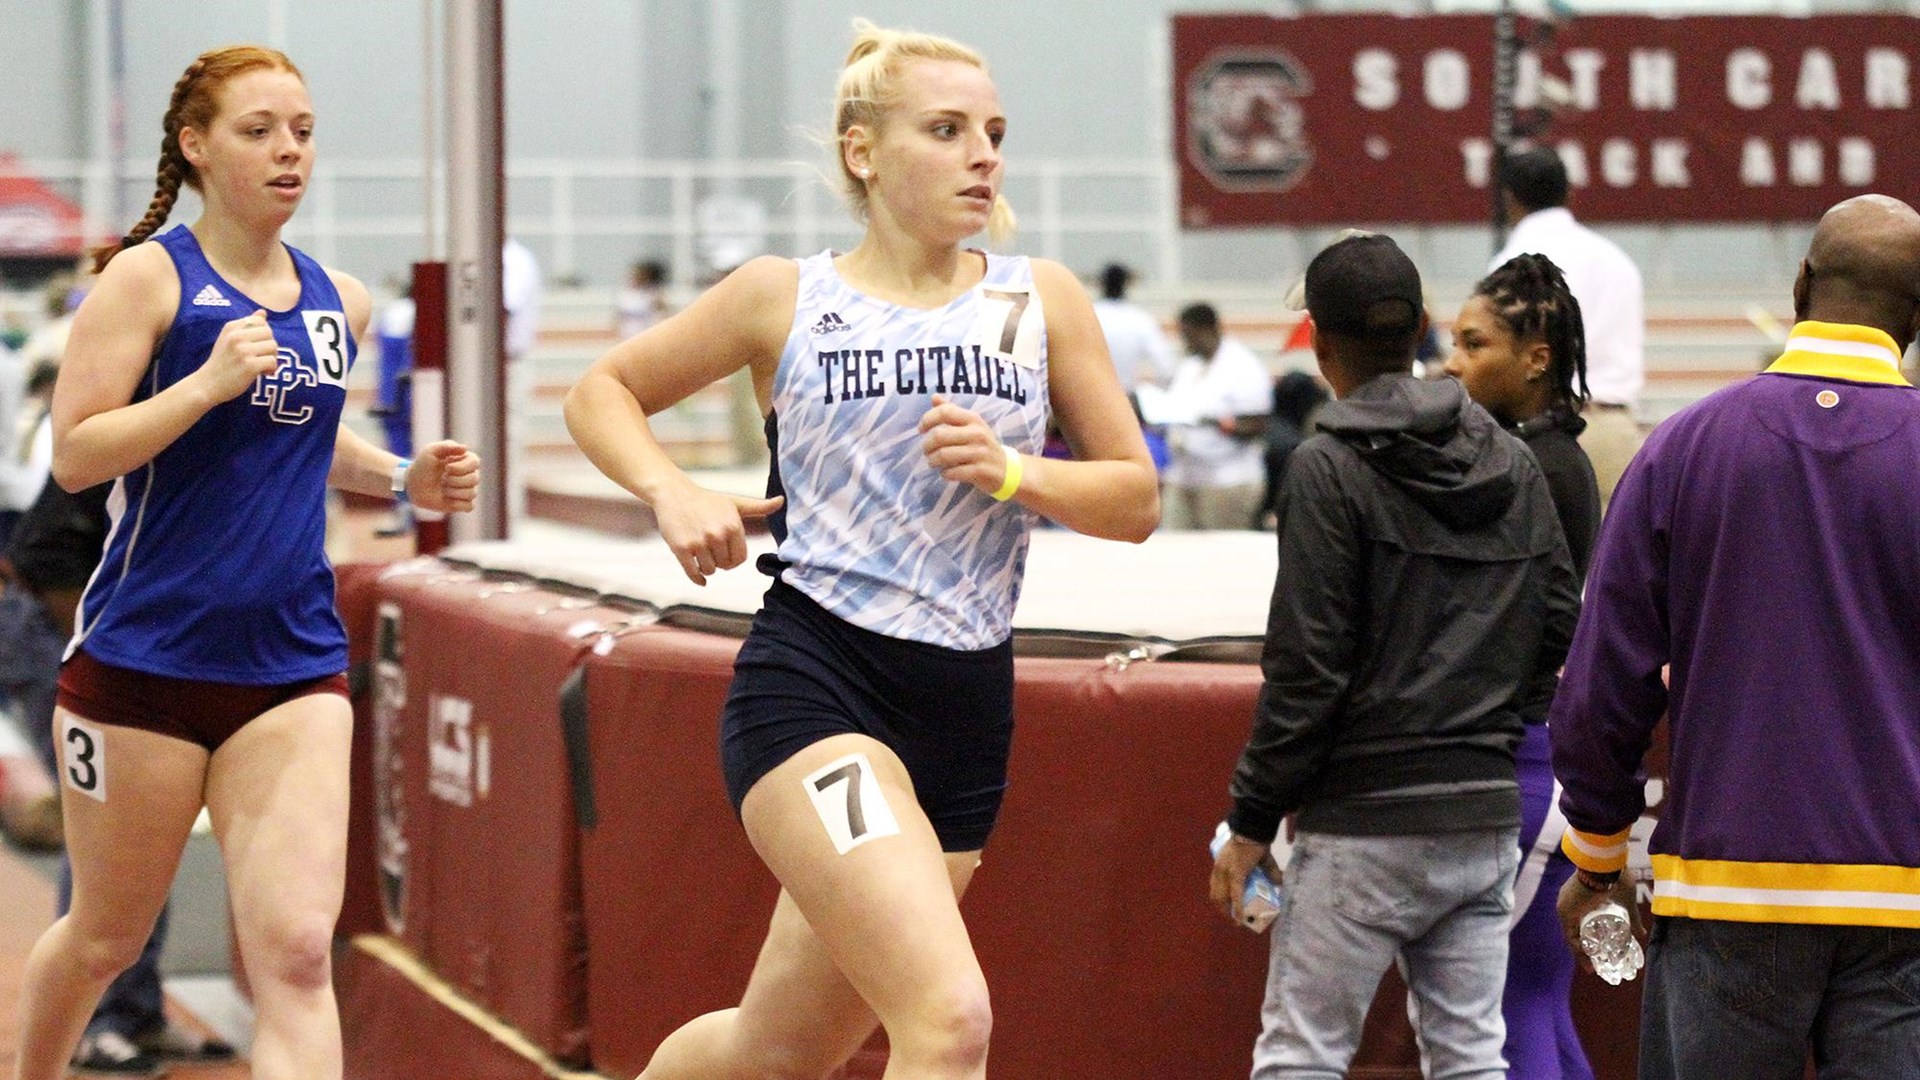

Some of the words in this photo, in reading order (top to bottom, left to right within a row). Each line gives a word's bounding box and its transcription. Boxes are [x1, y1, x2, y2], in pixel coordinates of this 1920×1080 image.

[1724, 49, 1911, 110] CAR
[1460, 137, 1691, 187] TACK
[1740, 138, 1876, 187] AND
[315, 316, 343, 380] 3
[811, 324, 851, 335] adidas
[983, 288, 1029, 355] 7
[818, 350, 885, 404] THE
[895, 345, 1026, 406] CITADEL
[67, 727, 97, 791] 3
[814, 761, 868, 840] 7
